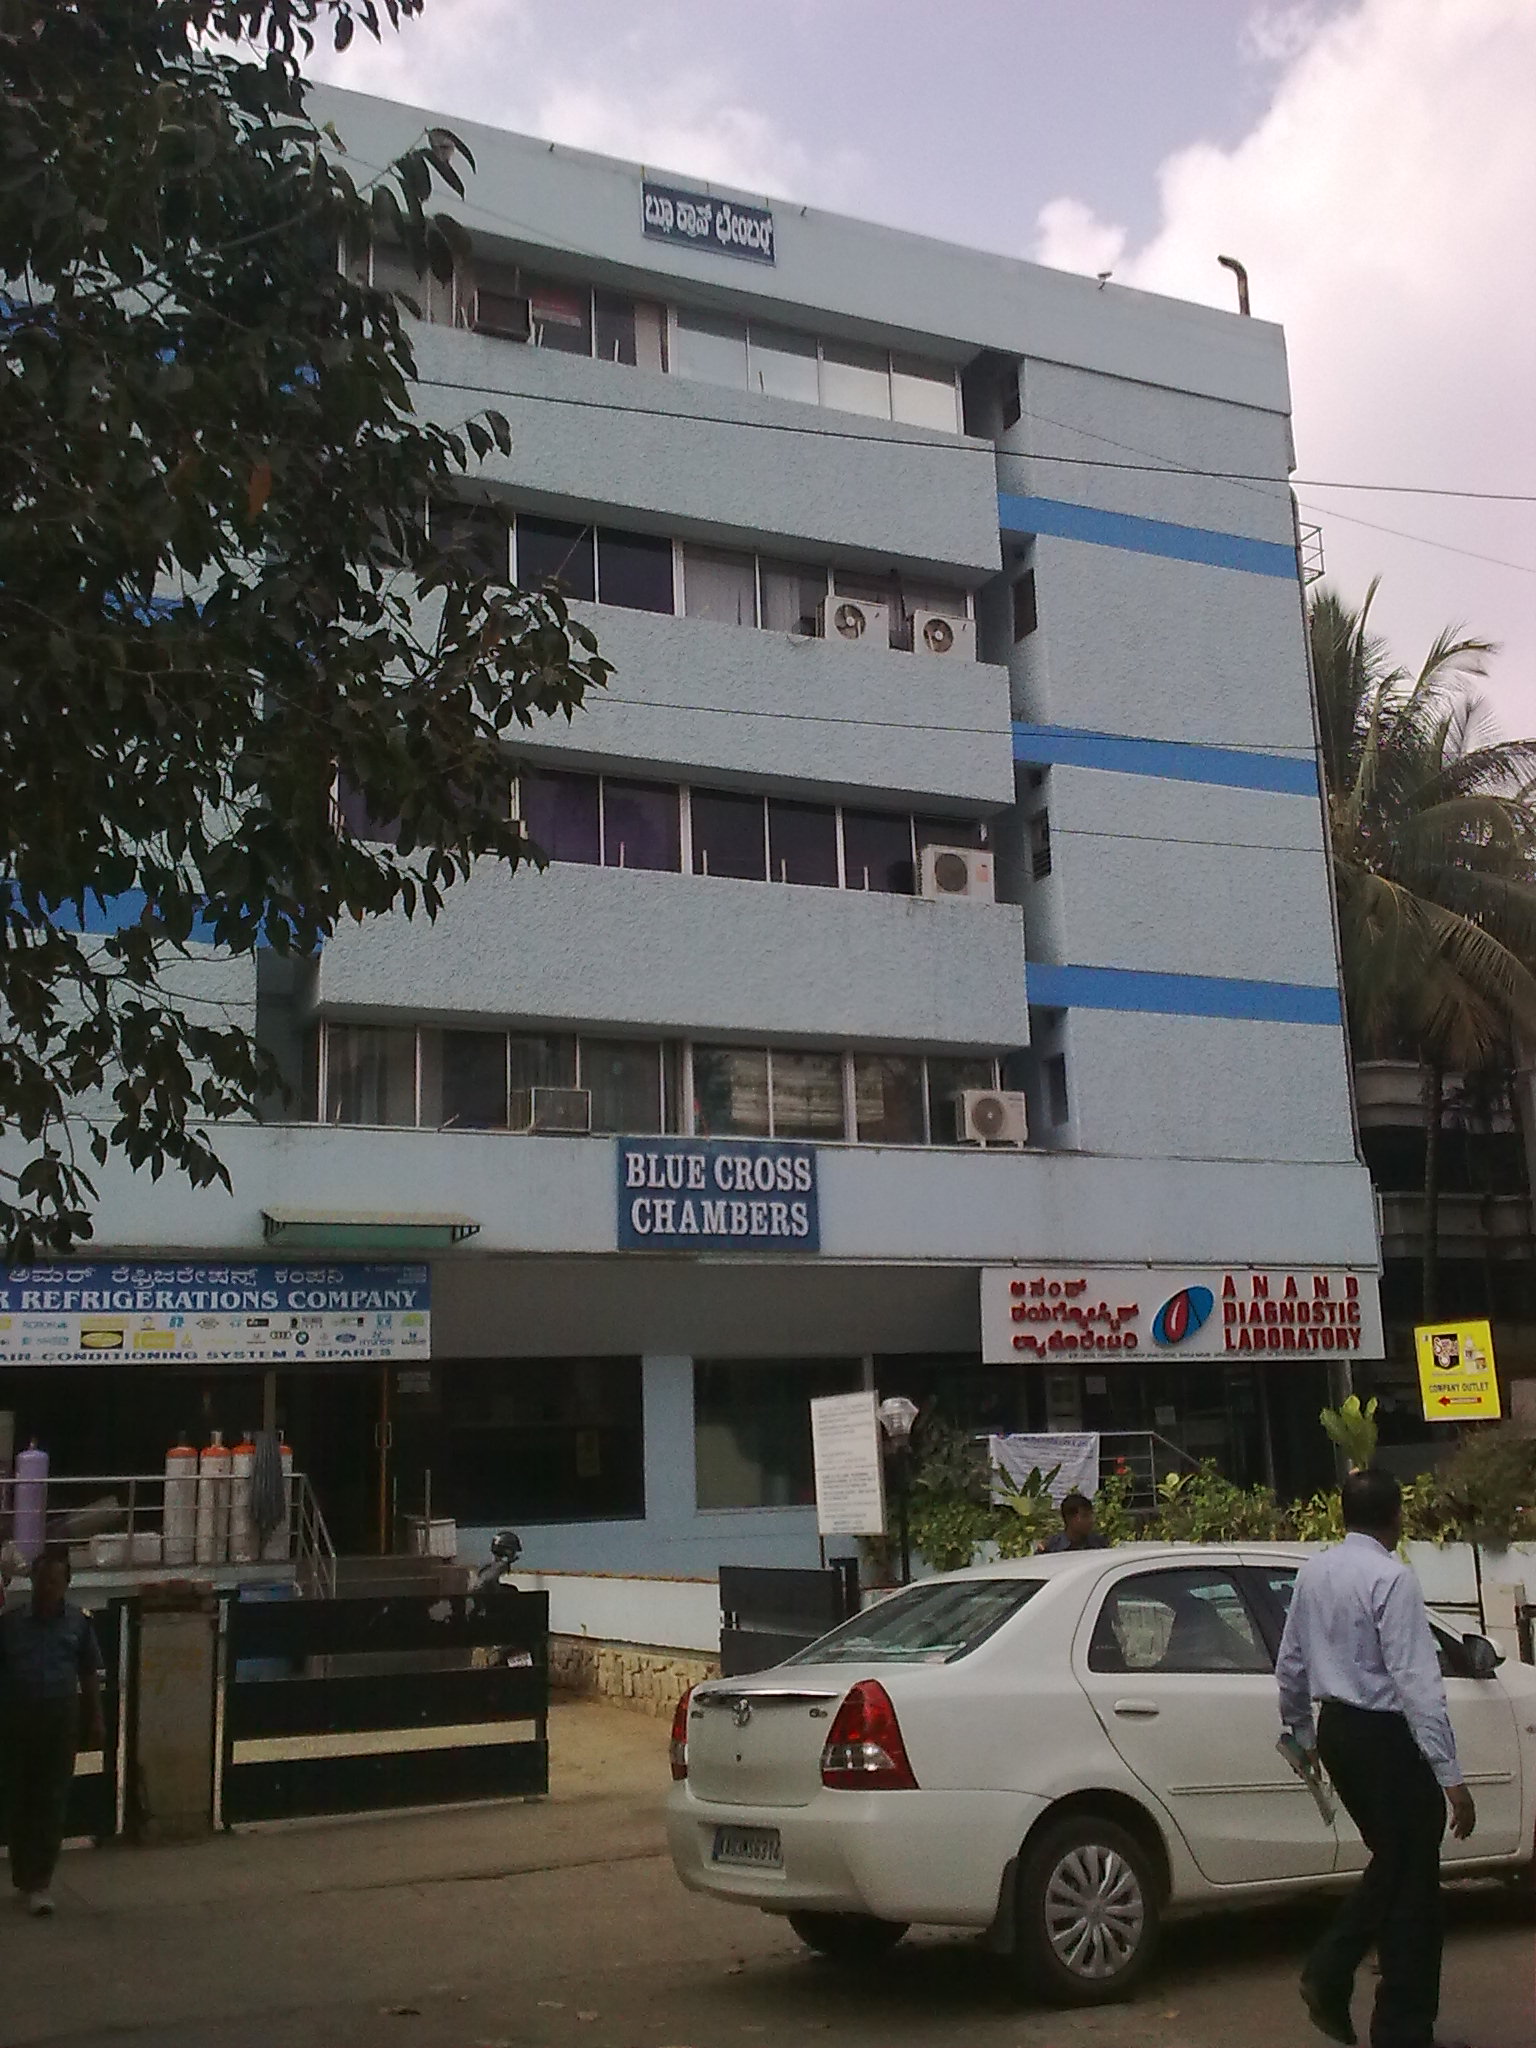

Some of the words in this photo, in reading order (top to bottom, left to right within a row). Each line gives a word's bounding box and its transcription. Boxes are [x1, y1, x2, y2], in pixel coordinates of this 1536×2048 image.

[626, 1153, 705, 1189] BLUE
[714, 1155, 812, 1191] CROSS
[631, 1198, 809, 1236] CHAMBERS
[1222, 1275, 1359, 1298] ANAND
[22, 1290, 279, 1310] REFRIGERATIONS
[288, 1290, 417, 1310] COMPANY
[1223, 1302, 1361, 1325] DIAGNOSTIC
[1224, 1327, 1362, 1350] LABORATORY
[207, 1350, 287, 1359] SYSTEM
[315, 1348, 391, 1358] SPARES
[1429, 1383, 1460, 1393] COMPANY
[1462, 1381, 1489, 1392] OUTLET
